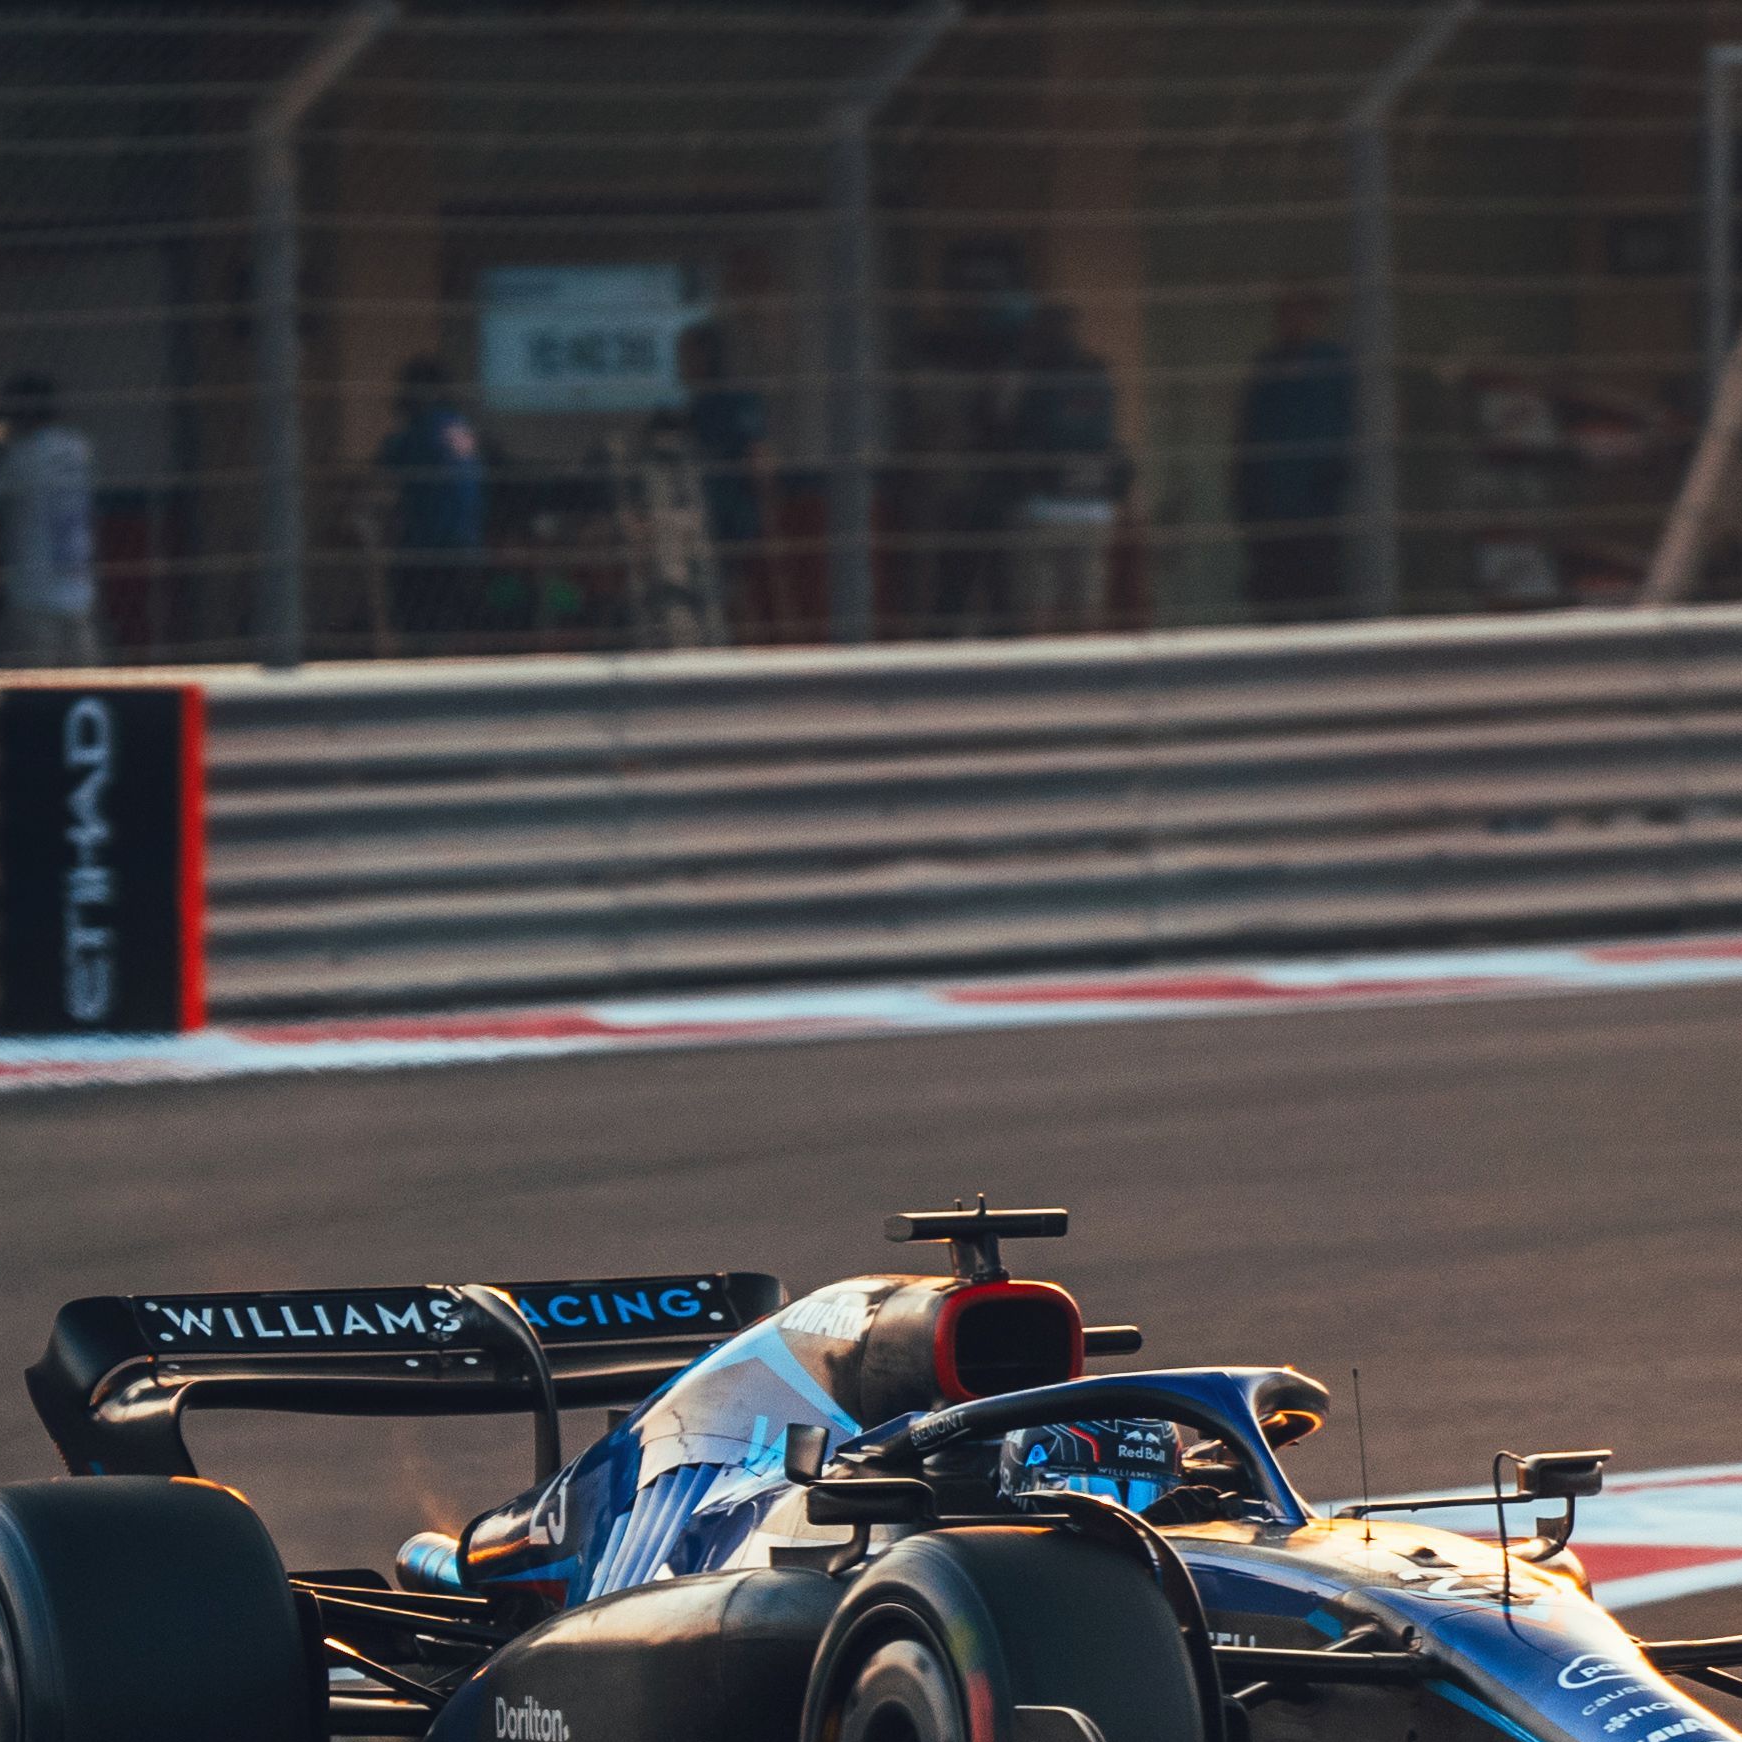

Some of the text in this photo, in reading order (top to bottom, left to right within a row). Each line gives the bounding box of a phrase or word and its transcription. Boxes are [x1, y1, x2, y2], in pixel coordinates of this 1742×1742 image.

[63, 697, 109, 1021] ETIHAD
[161, 1288, 702, 1338] WILLIAMS ACING
[910, 1410, 966, 1447] BREMONT
[1118, 1444, 1166, 1463] Red Bull
[1098, 1466, 1153, 1480] WILLIAMS
